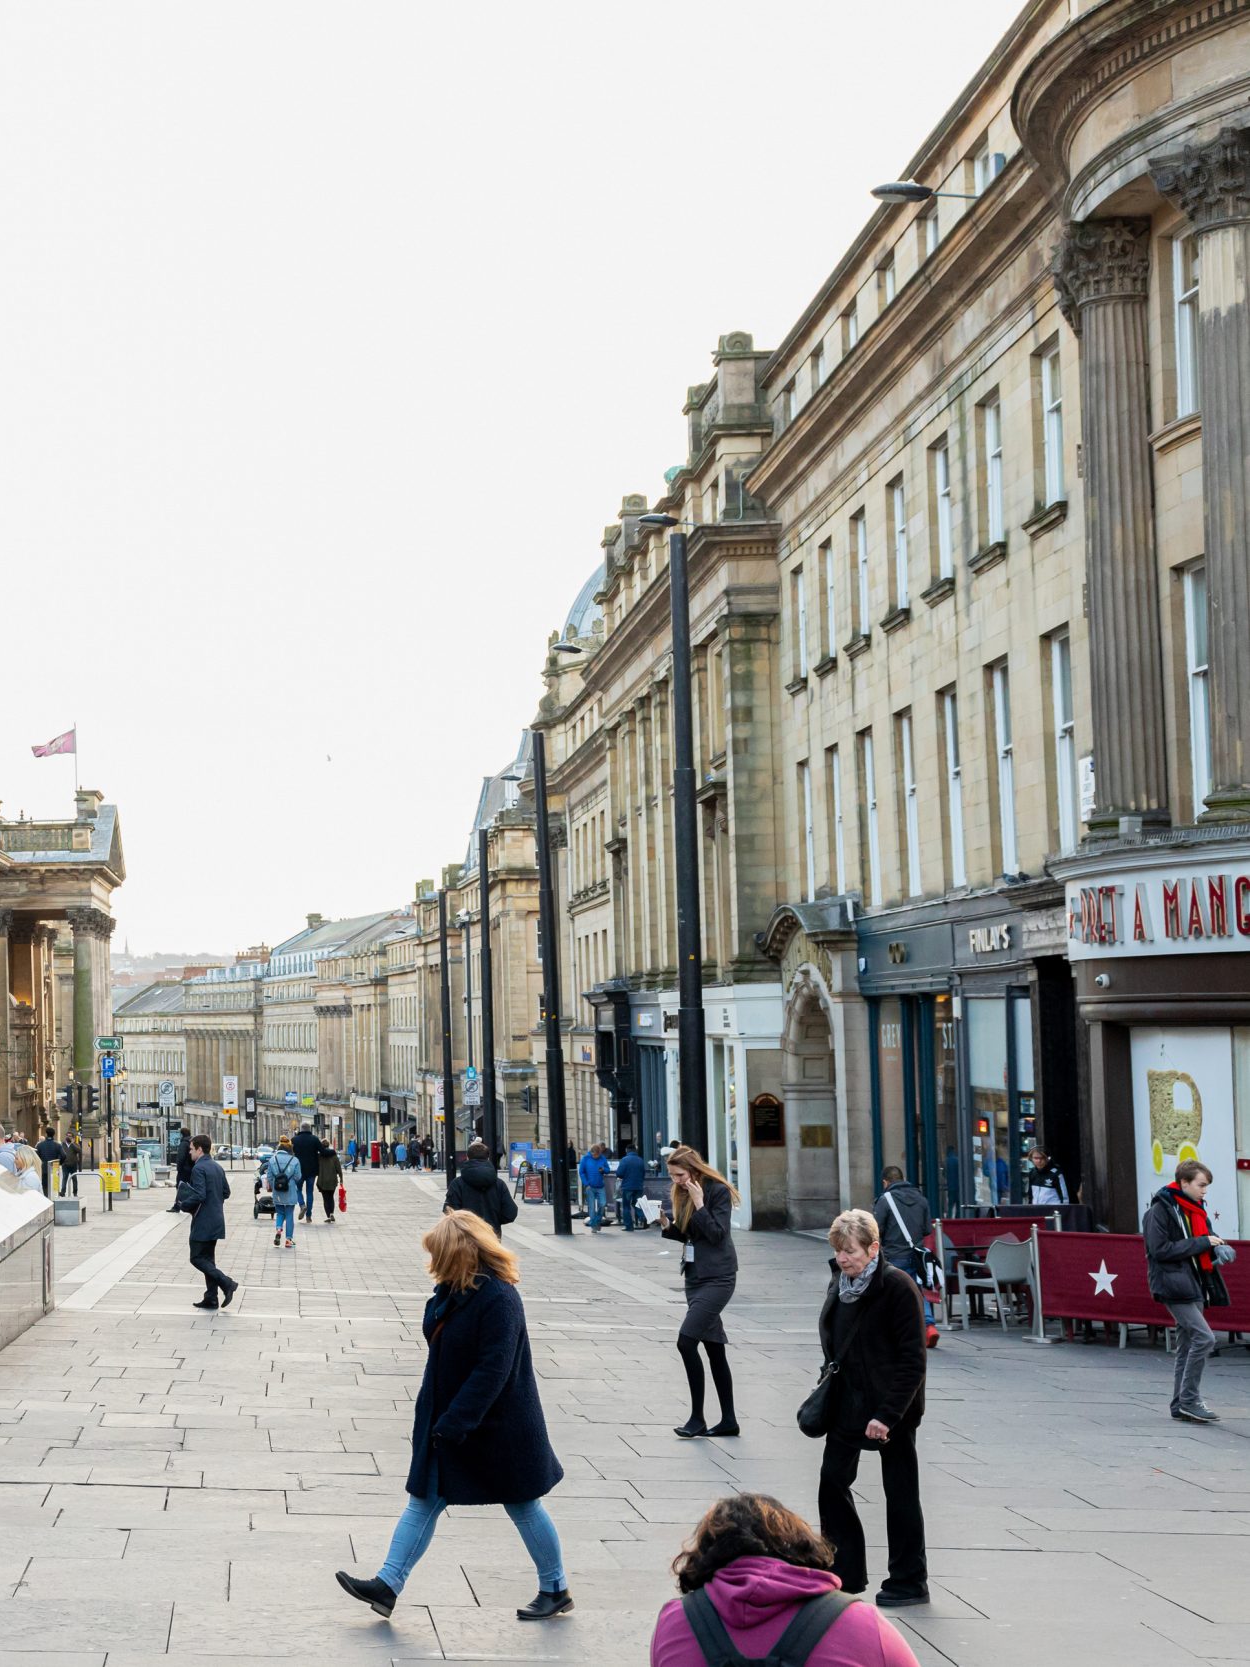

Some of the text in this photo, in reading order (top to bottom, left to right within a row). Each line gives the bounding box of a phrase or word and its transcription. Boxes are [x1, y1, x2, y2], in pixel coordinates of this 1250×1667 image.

[1080, 885, 1124, 944] PRET
[1133, 883, 1153, 942] A
[881, 1023, 901, 1049] GREY
[105, 1059, 113, 1069] P
